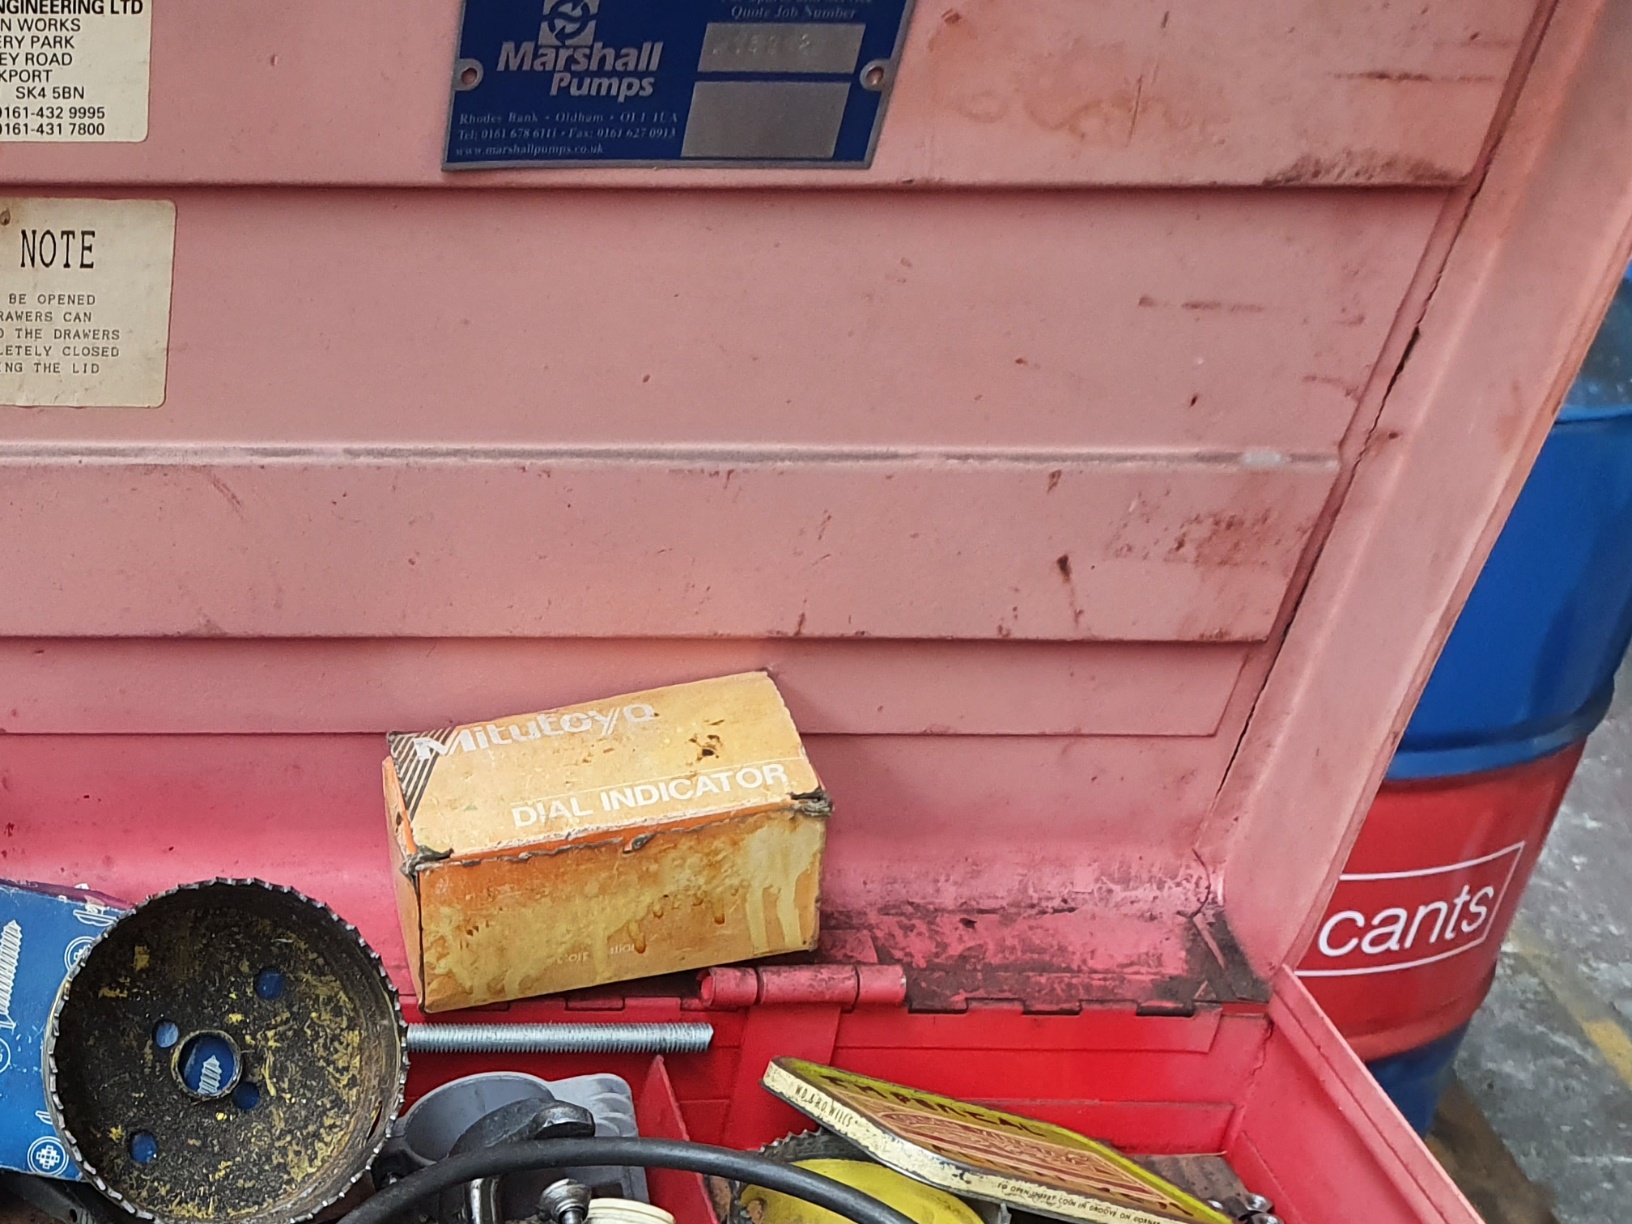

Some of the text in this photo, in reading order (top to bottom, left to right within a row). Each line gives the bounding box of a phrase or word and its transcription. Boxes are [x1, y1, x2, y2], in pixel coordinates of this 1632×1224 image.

[109, 0, 143, 15] LTD
[17, 18, 81, 32] WORKS
[30, 35, 75, 49] PARK
[24, 52, 73, 66] ROAD
[497, 41, 664, 72] Marshall
[15, 86, 47, 100] SK4
[52, 86, 85, 100] 5BN
[550, 72, 655, 102] Pumps
[69, 106, 105, 119] 9995
[69, 122, 105, 136] 7800
[20, 229, 96, 270] NOTE
[9, 294, 27, 305] BE
[37, 294, 96, 306] OPENED
[62, 311, 92, 323] CAN
[15, 327, 42, 339] THE
[53, 328, 120, 341] DRAWERS
[62, 345, 120, 358] CLOSED
[33, 362, 61, 374] THE
[72, 362, 101, 374] LID
[414, 702, 656, 761] Mitutoyo
[512, 763, 788, 828] DIAL INDICATOR
[1318, 885, 1494, 957] cants
